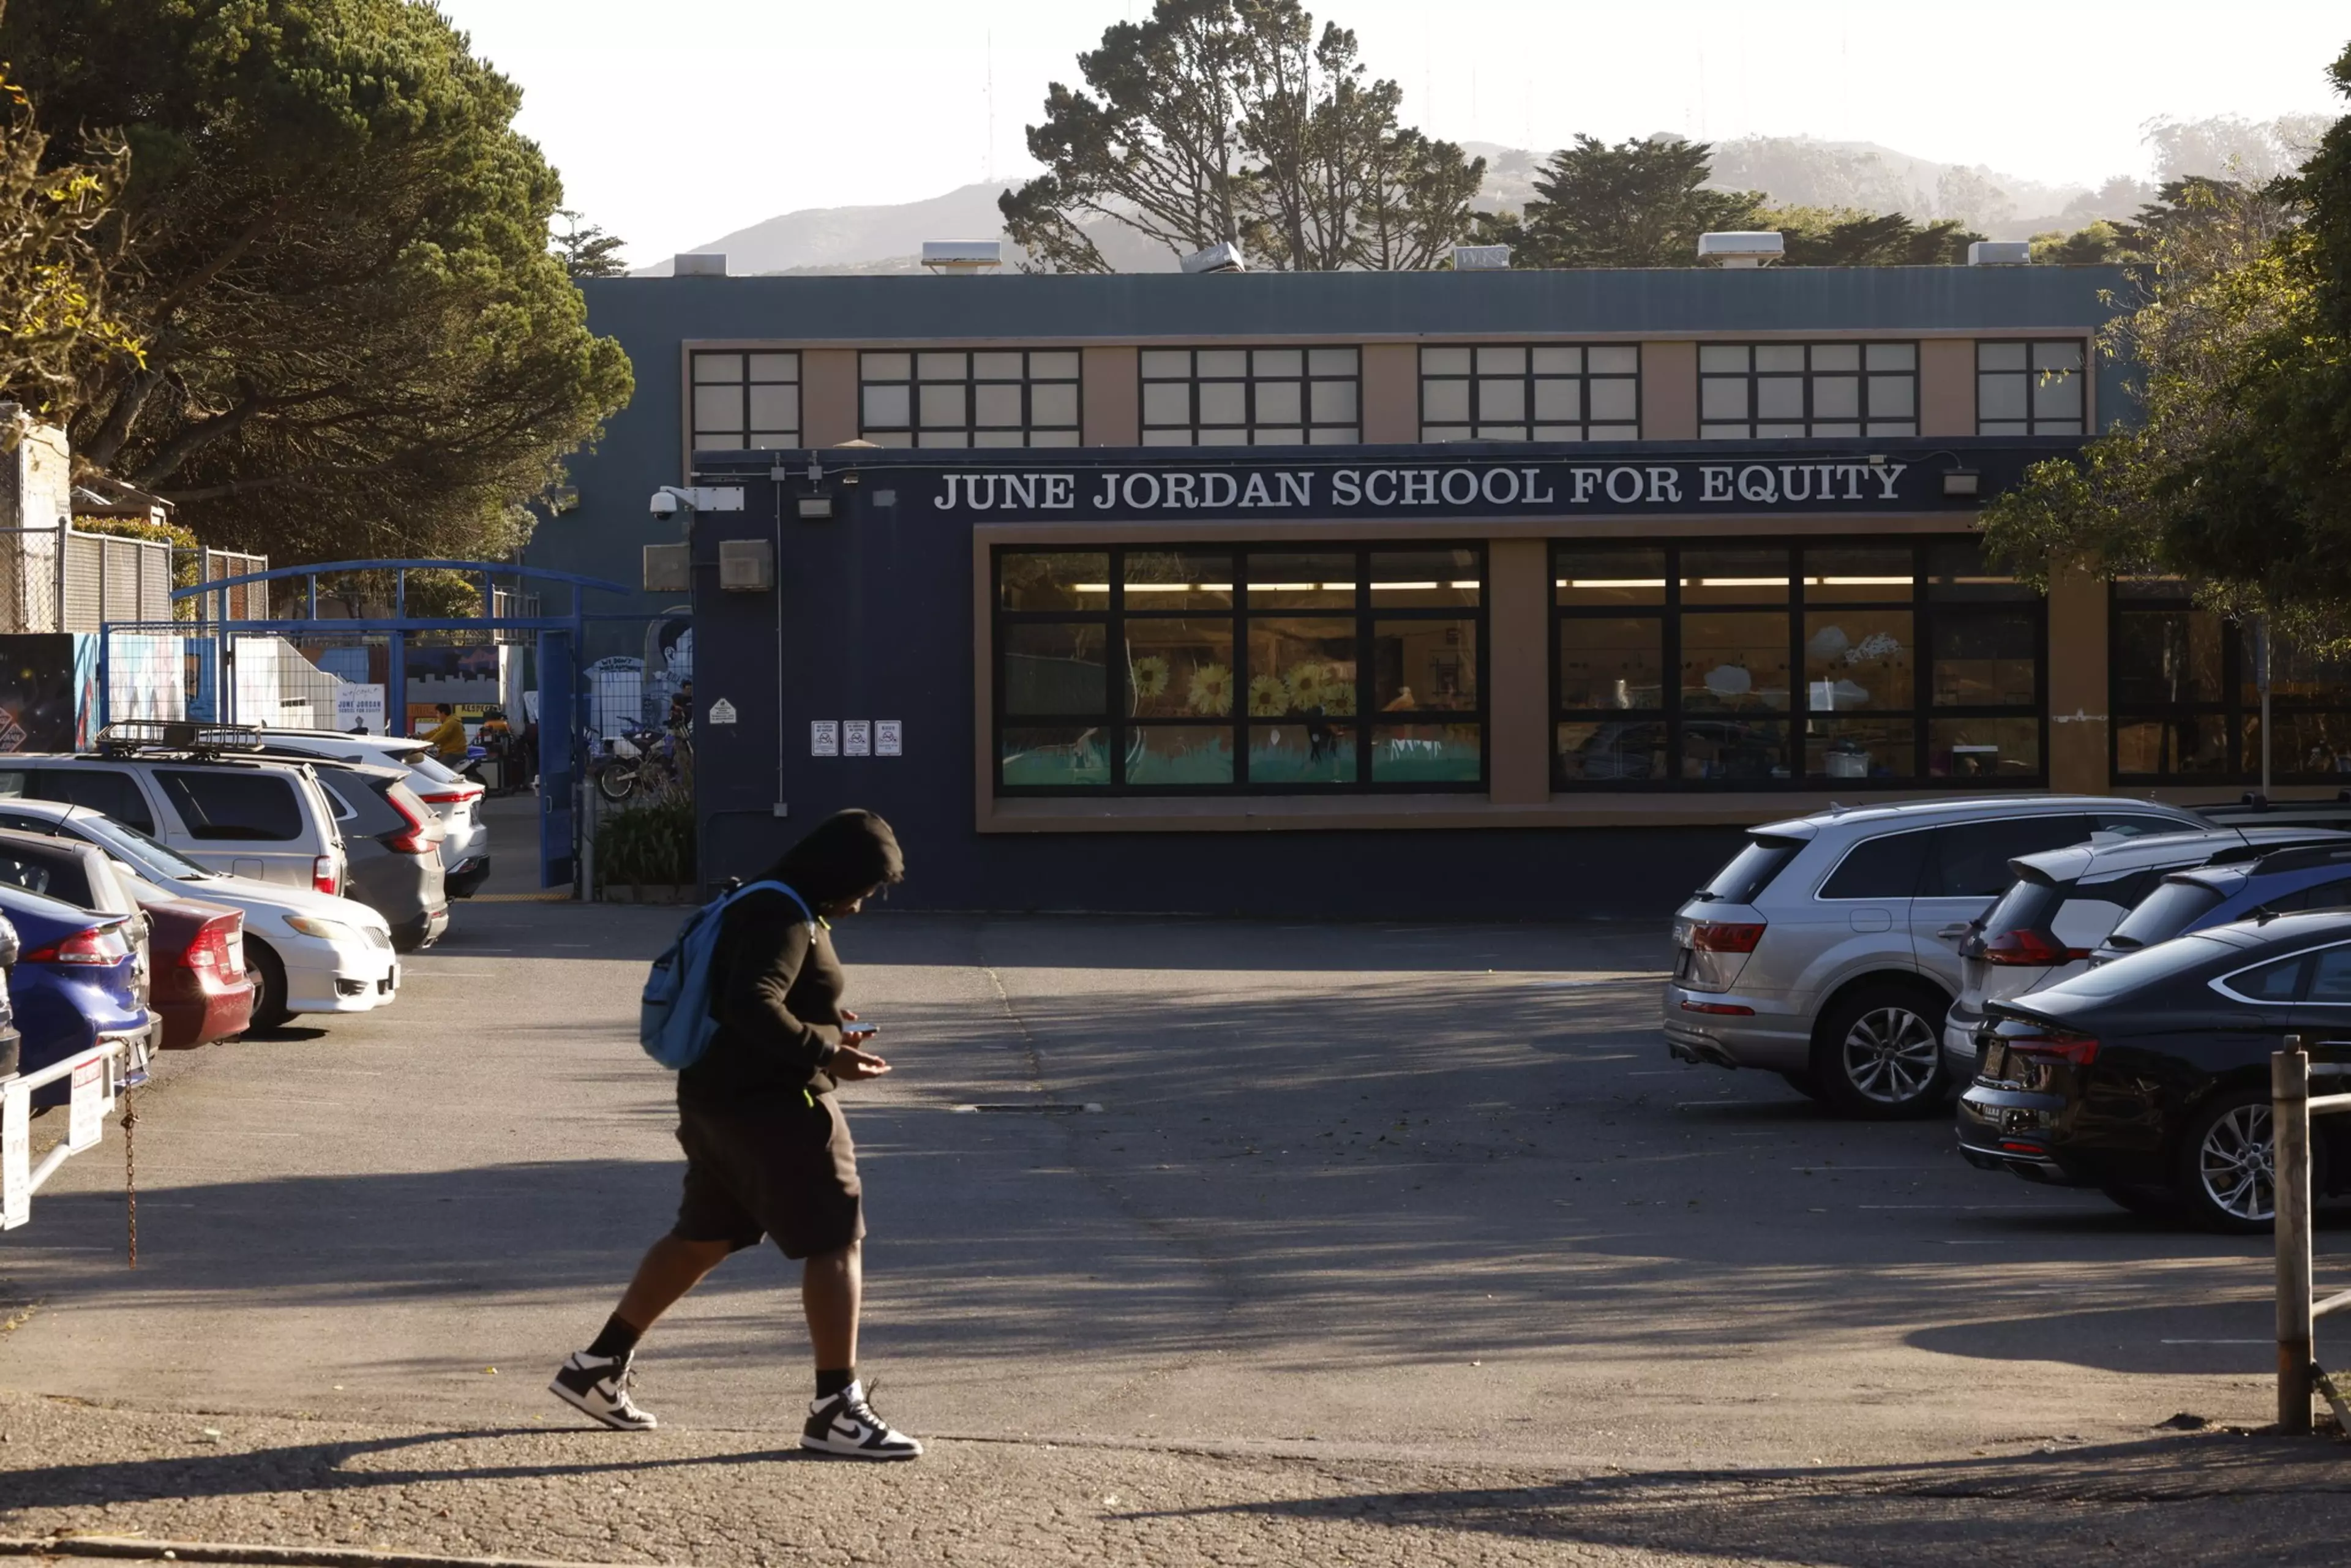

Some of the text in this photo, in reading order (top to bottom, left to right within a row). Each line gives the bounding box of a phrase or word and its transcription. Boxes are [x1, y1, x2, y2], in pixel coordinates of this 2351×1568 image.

[934, 465, 1907, 510] JUNE JORDAN SCHOOL FOR EQUITY
